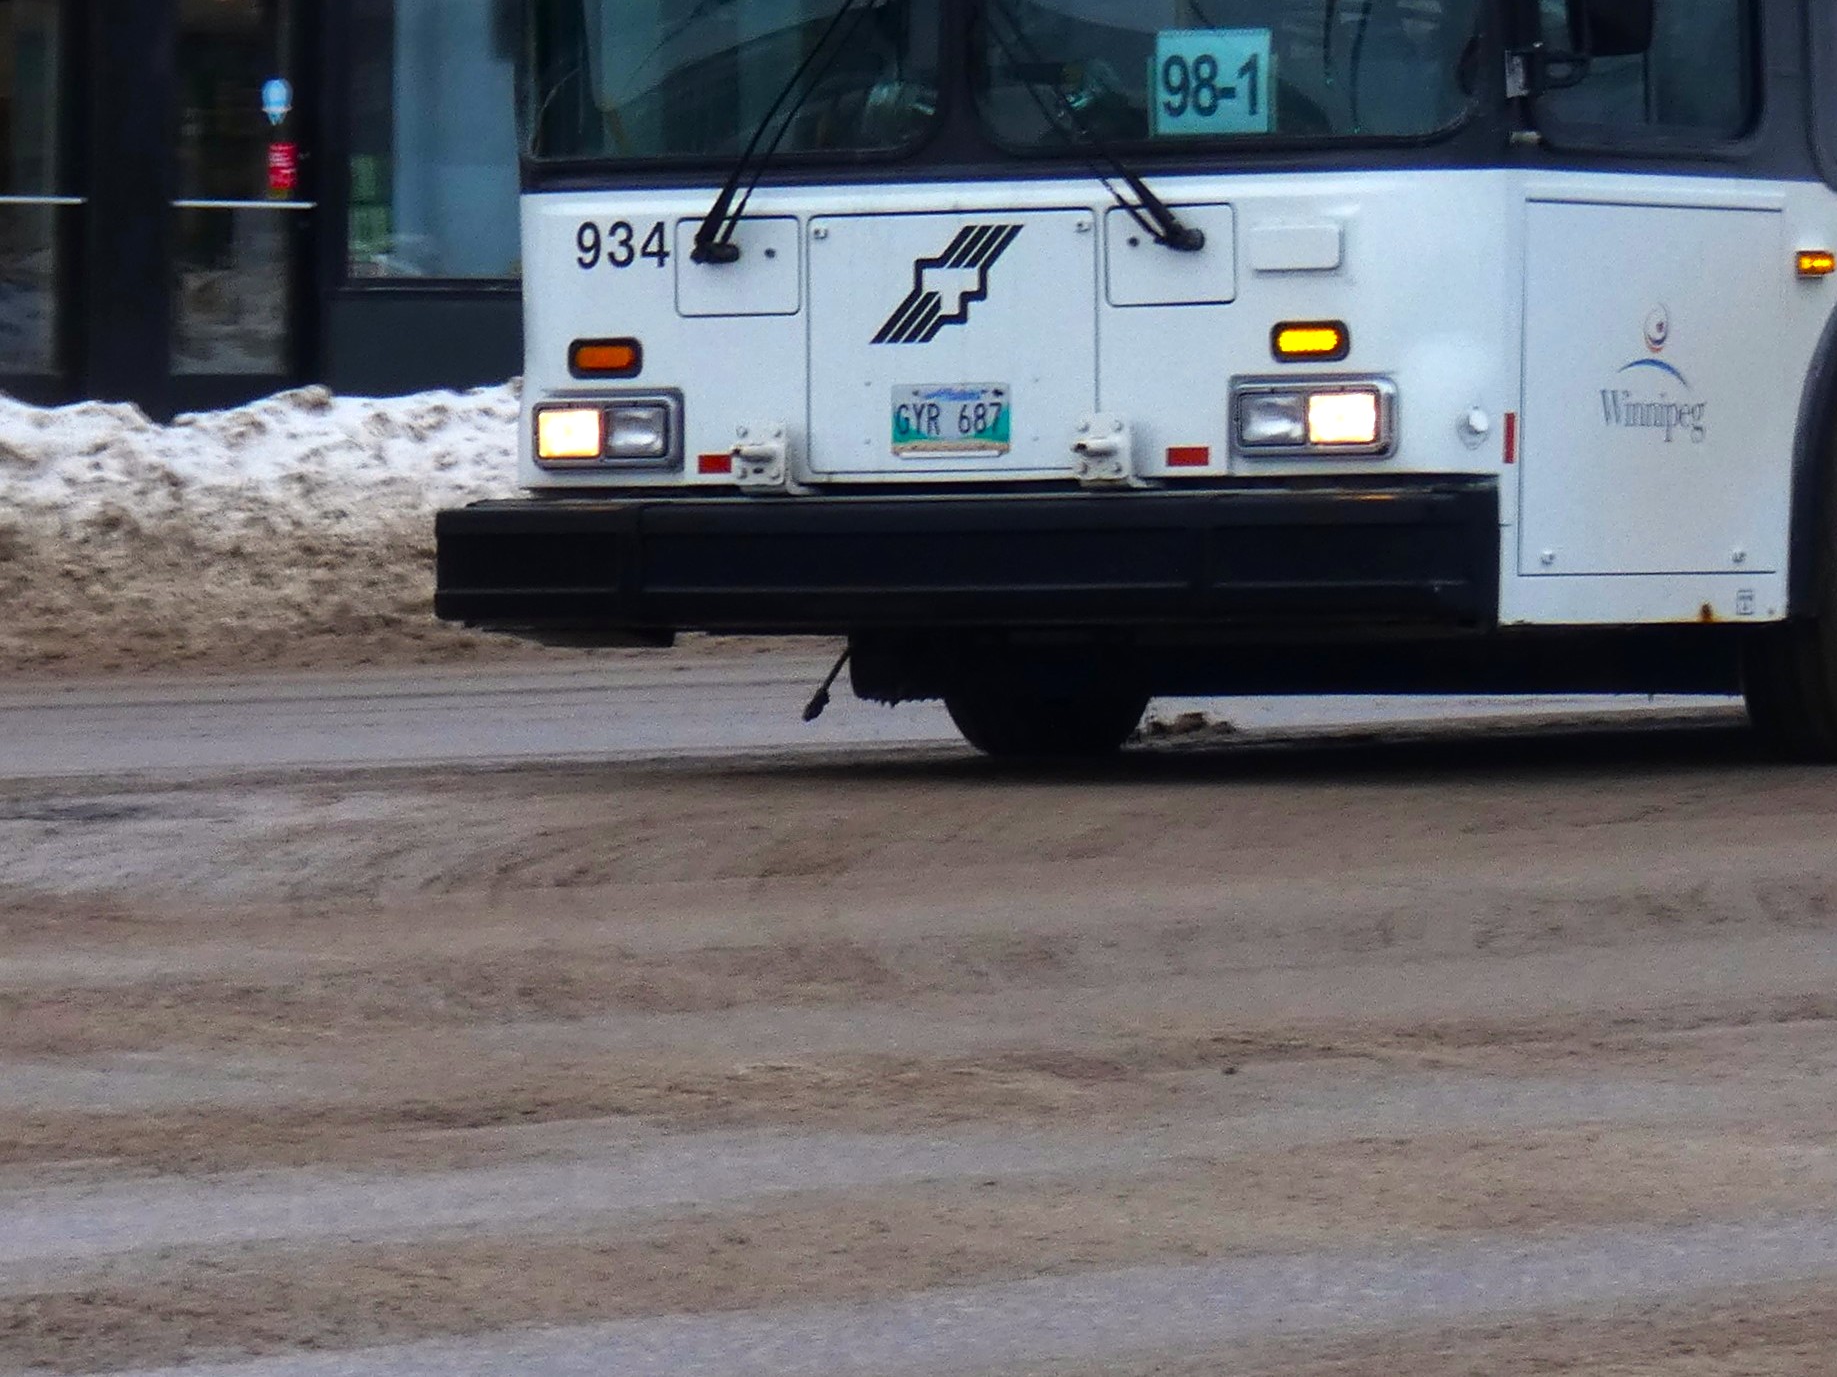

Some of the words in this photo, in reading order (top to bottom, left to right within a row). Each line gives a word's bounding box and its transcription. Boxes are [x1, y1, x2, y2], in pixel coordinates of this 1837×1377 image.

[1162, 53, 1259, 118] 98-1
[576, 221, 670, 270] 934
[958, 402, 1002, 434] 687
[1600, 389, 1708, 444] Winnipeg
